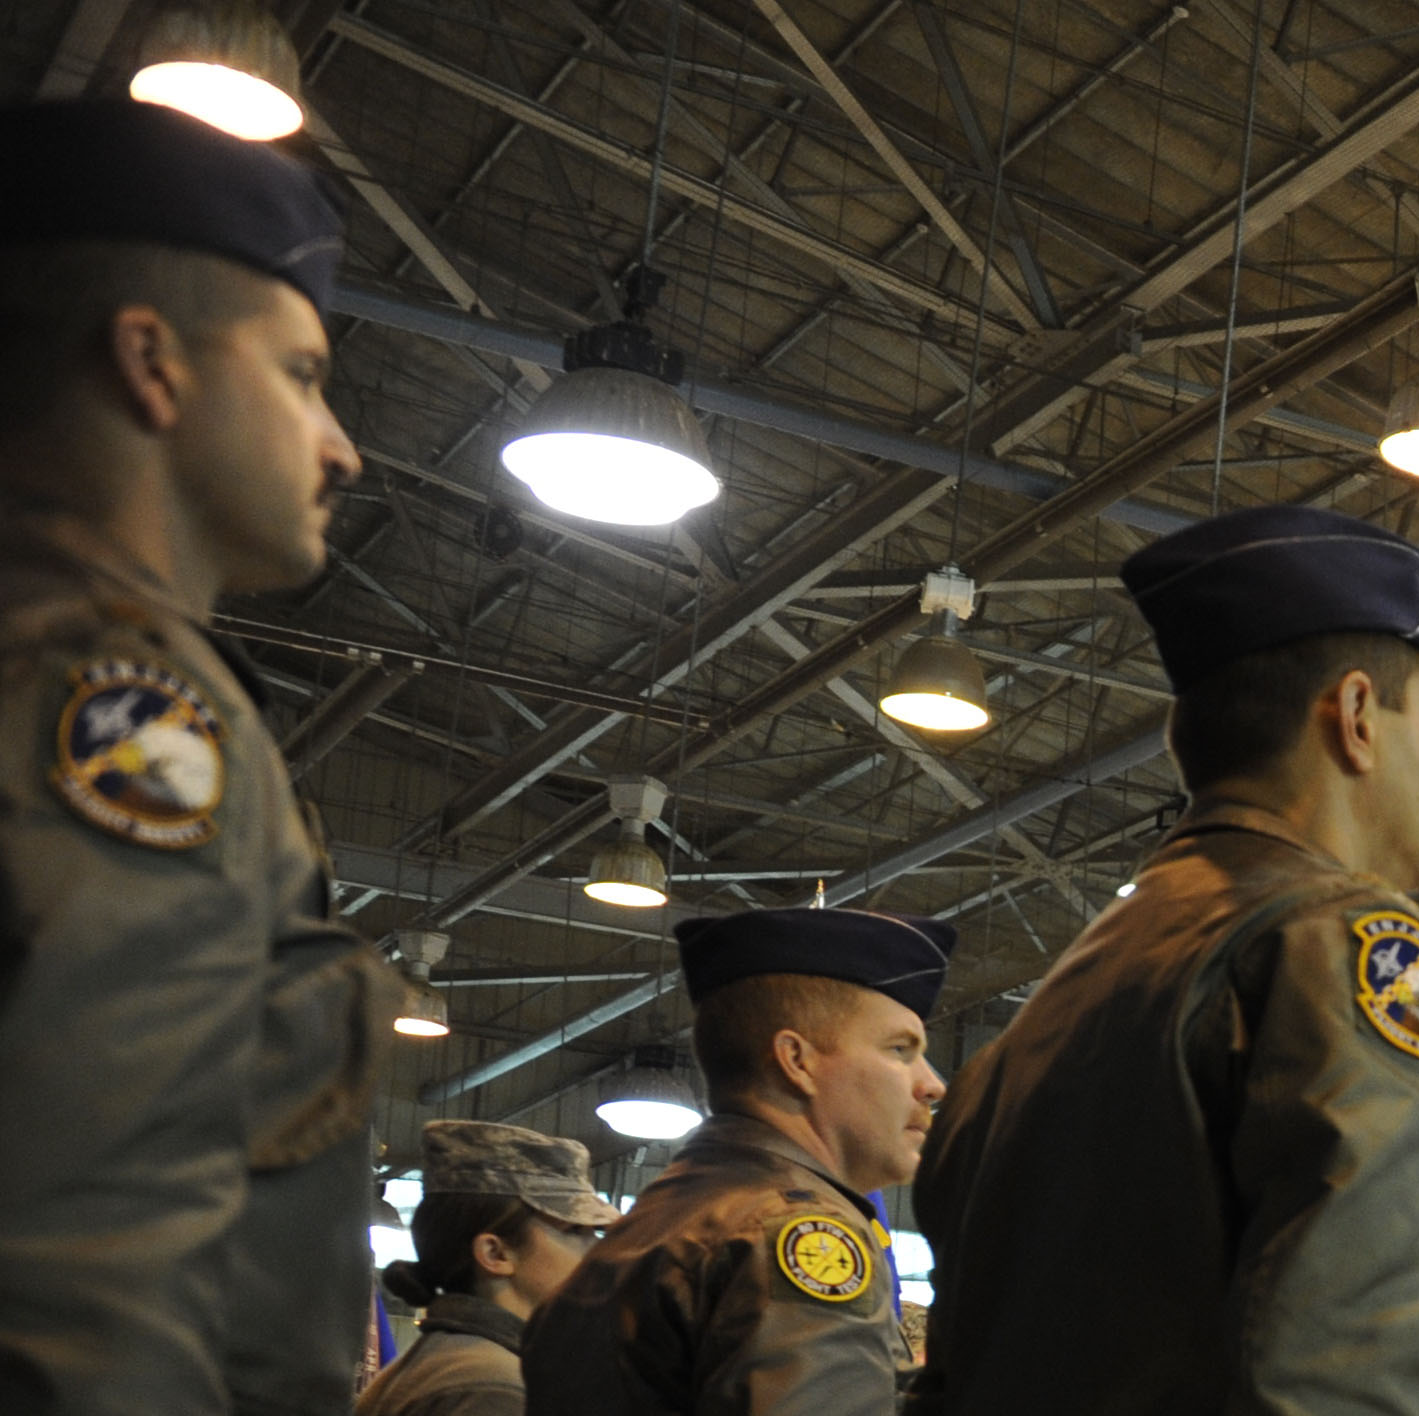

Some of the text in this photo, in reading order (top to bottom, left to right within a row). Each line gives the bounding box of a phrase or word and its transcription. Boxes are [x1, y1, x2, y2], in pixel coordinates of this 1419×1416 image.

[816, 1222, 845, 1238] FTW
[791, 1266, 862, 1296] FLIGHT TEST
